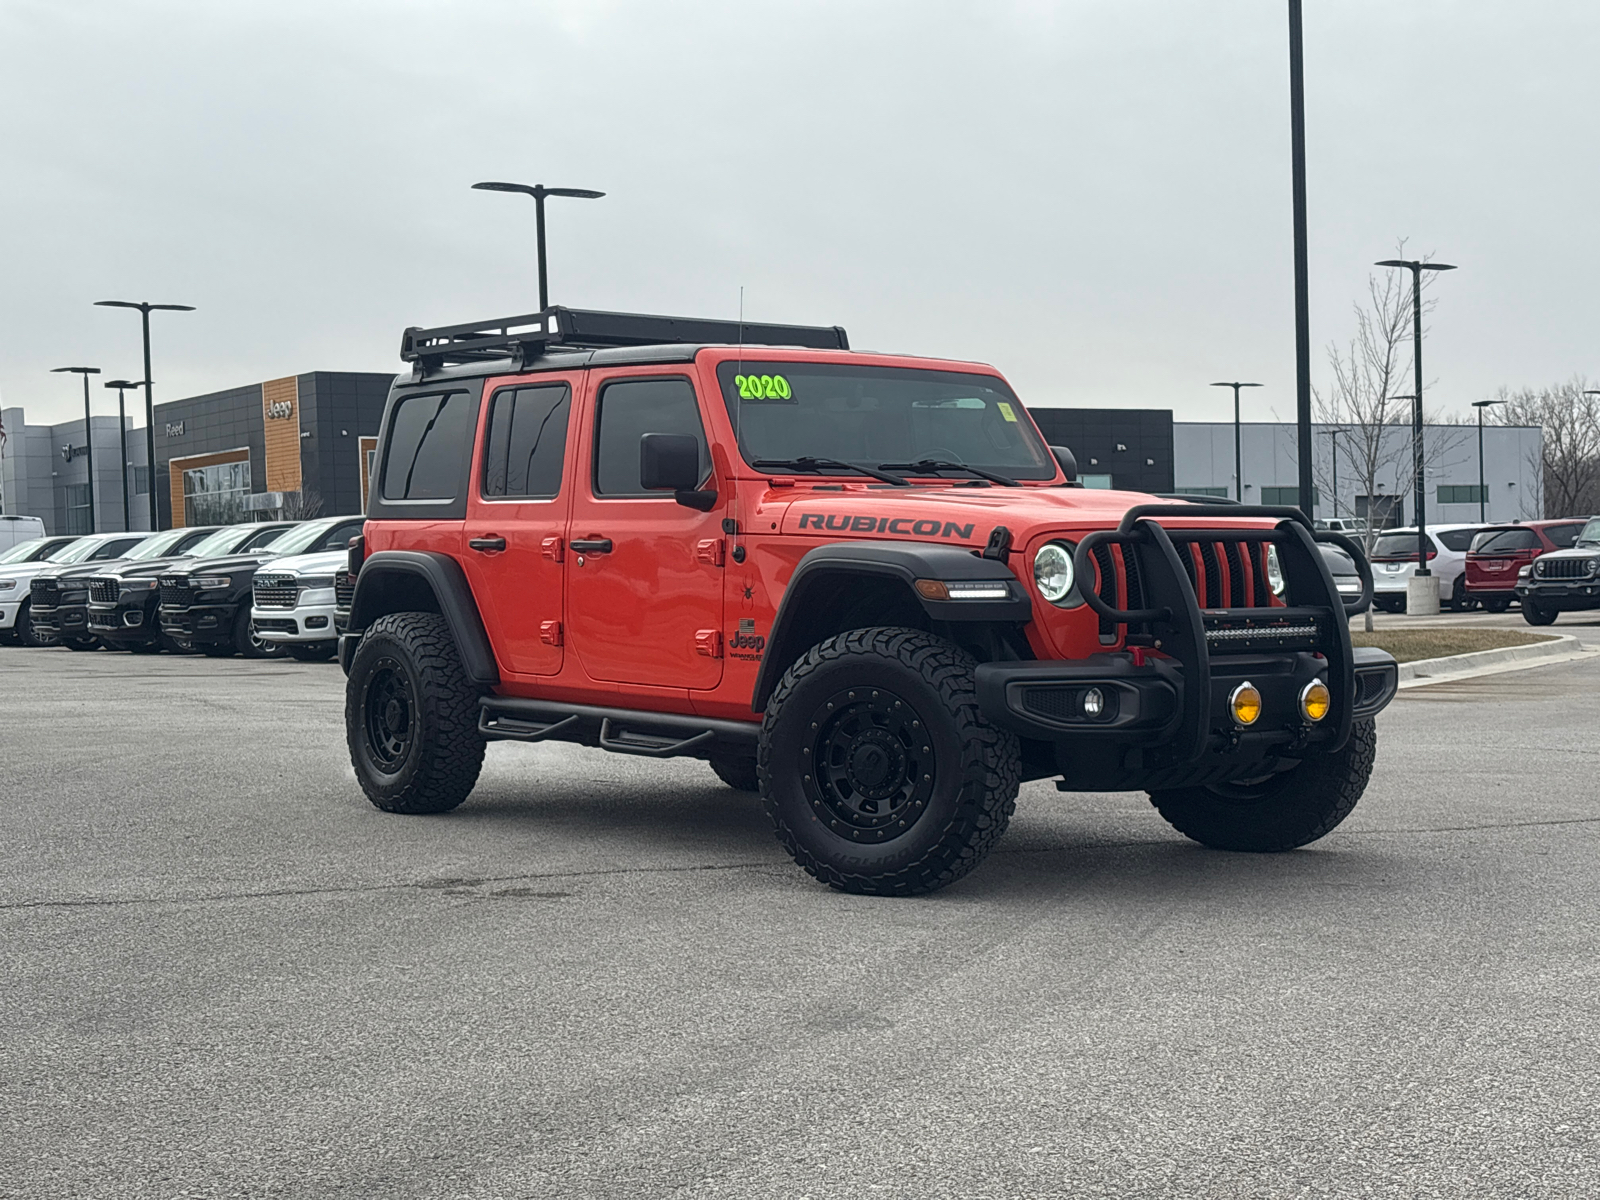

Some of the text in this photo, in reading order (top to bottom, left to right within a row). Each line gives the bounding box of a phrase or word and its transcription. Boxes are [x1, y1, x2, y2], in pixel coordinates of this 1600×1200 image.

[735, 374, 792, 400] 2020
[267, 399, 293, 420] Jeep
[166, 421, 185, 438] Reed
[798, 513, 976, 539] RUBICON
[729, 629, 765, 653] Jeep
